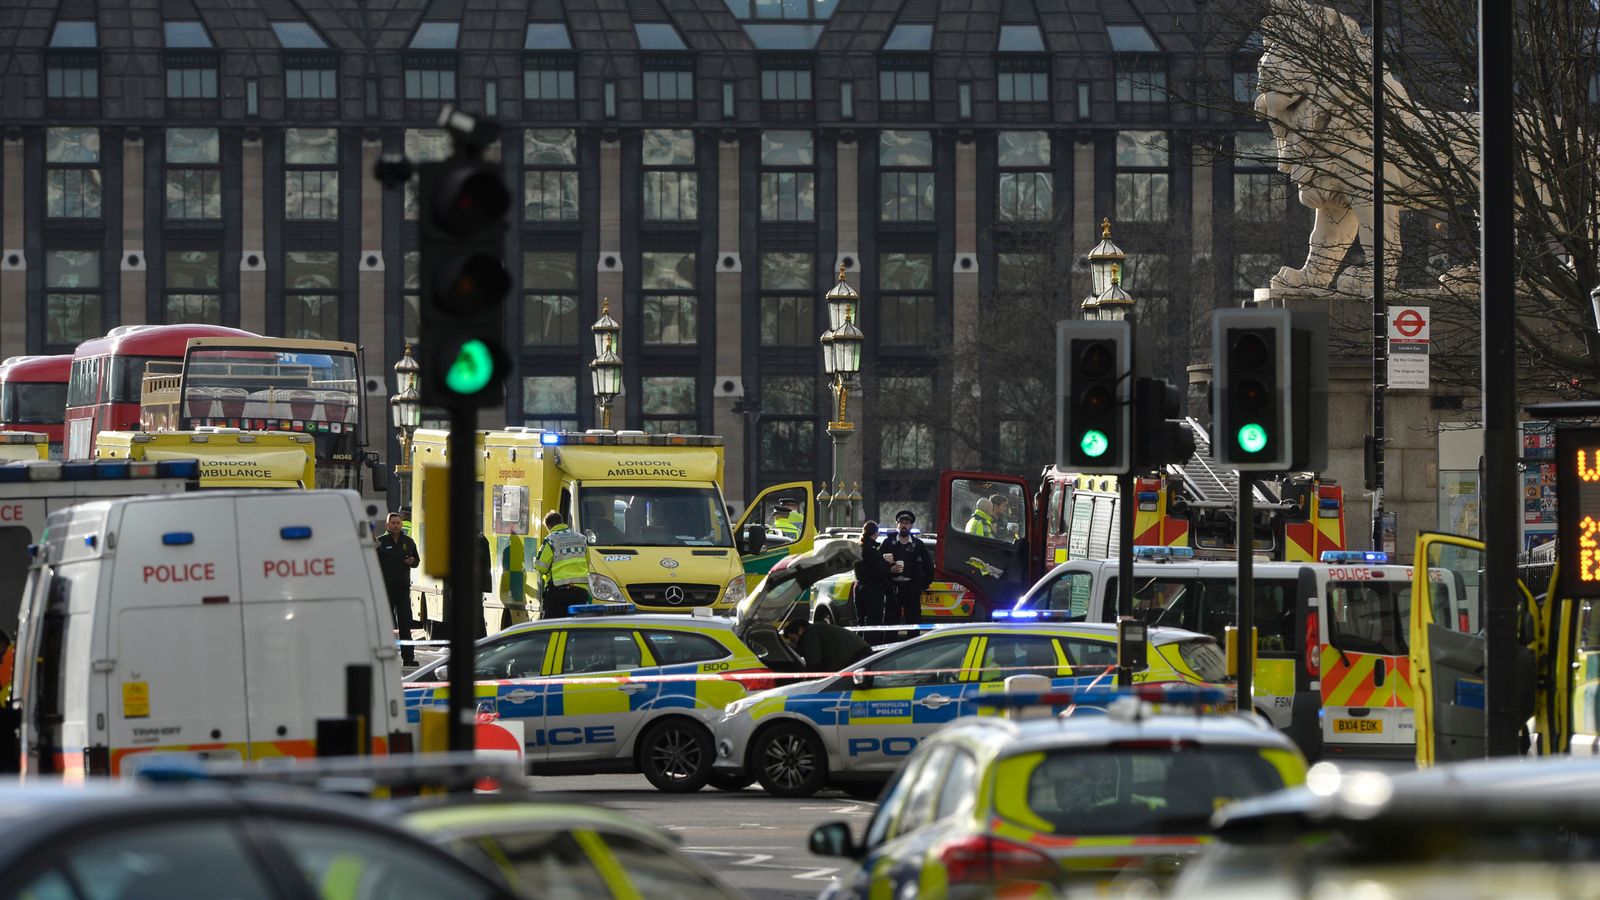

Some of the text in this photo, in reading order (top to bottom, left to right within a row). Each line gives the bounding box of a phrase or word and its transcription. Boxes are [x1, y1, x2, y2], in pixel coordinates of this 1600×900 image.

[199, 469, 272, 478] MBULANCE
[607, 468, 688, 477] AMBULANCE
[143, 563, 215, 583] POLICE
[263, 558, 335, 578] POLICE
[1328, 568, 1371, 580] POLICE
[1338, 721, 1358, 731] BX14
